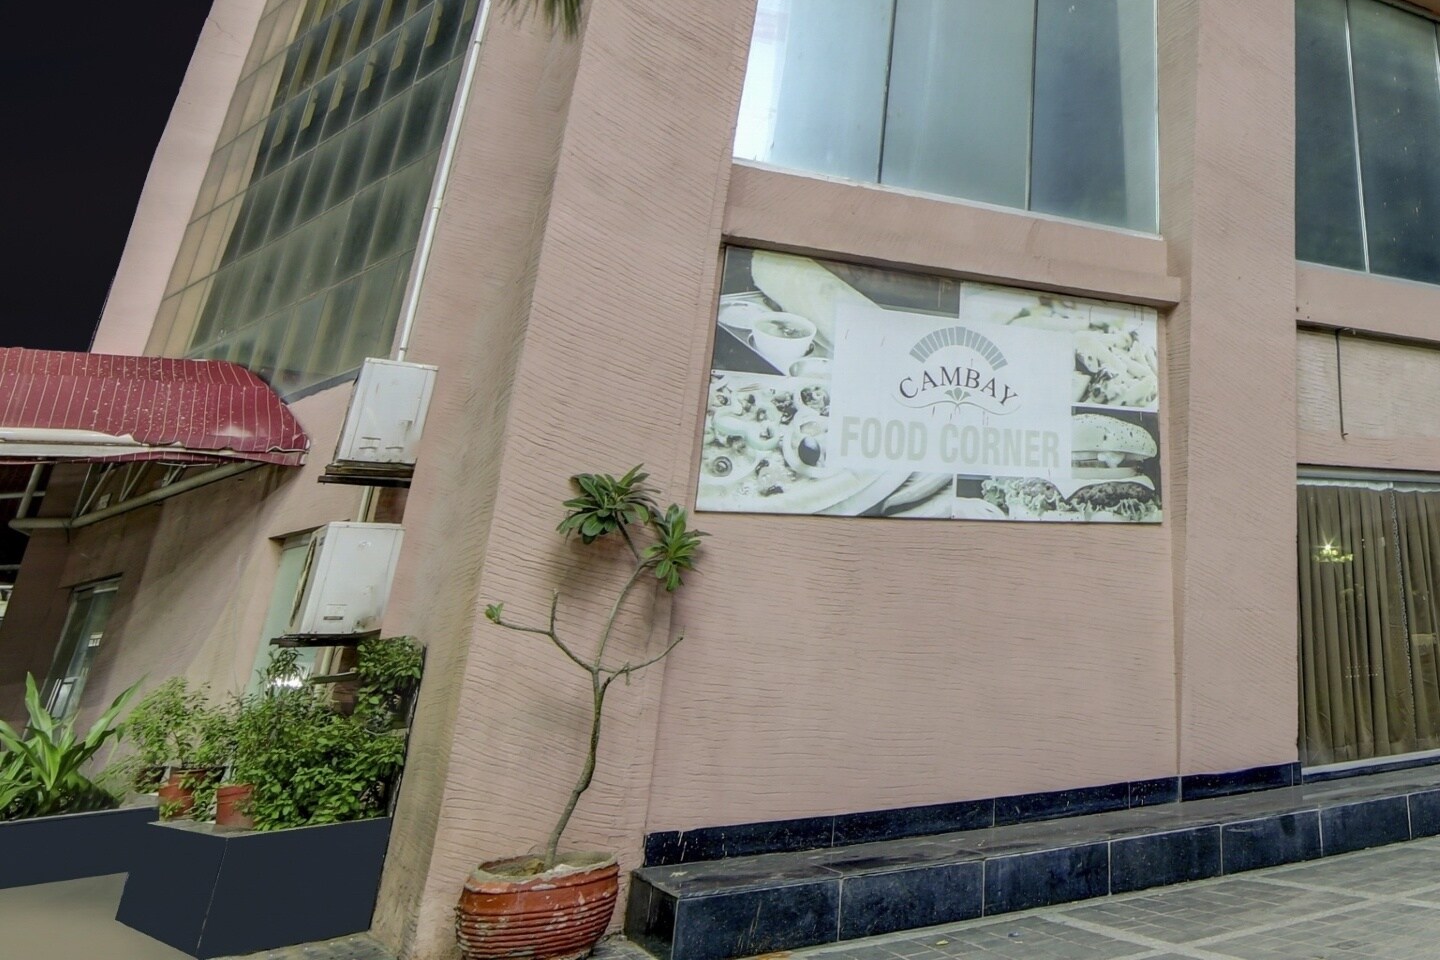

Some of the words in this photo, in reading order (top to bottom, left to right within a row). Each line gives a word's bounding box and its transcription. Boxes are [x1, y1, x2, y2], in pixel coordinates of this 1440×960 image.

[899, 366, 1018, 407] CAMBAY
[840, 416, 927, 461] FOOD
[939, 424, 1060, 468] CORNER
